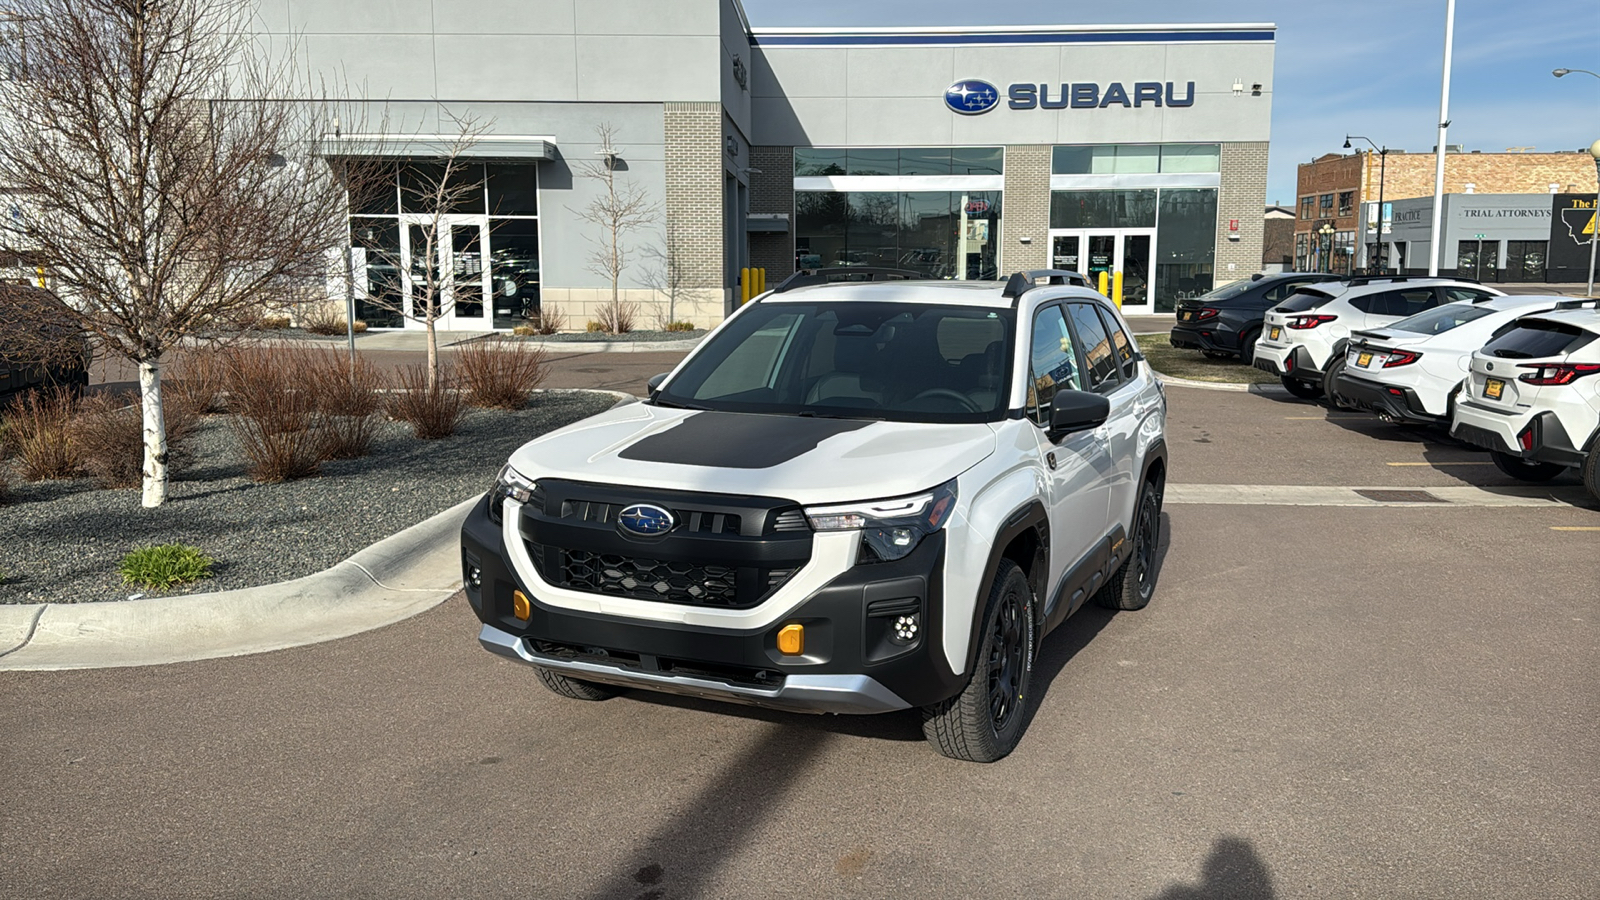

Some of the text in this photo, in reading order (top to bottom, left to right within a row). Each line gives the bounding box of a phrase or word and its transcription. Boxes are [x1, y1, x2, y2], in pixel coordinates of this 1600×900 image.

[1008, 81, 1196, 109] SUBARU
[1572, 199, 1590, 208] The
[1394, 210, 1421, 222] PRACTICE
[1464, 208, 1552, 218] TRIAL ATTORNEYS
